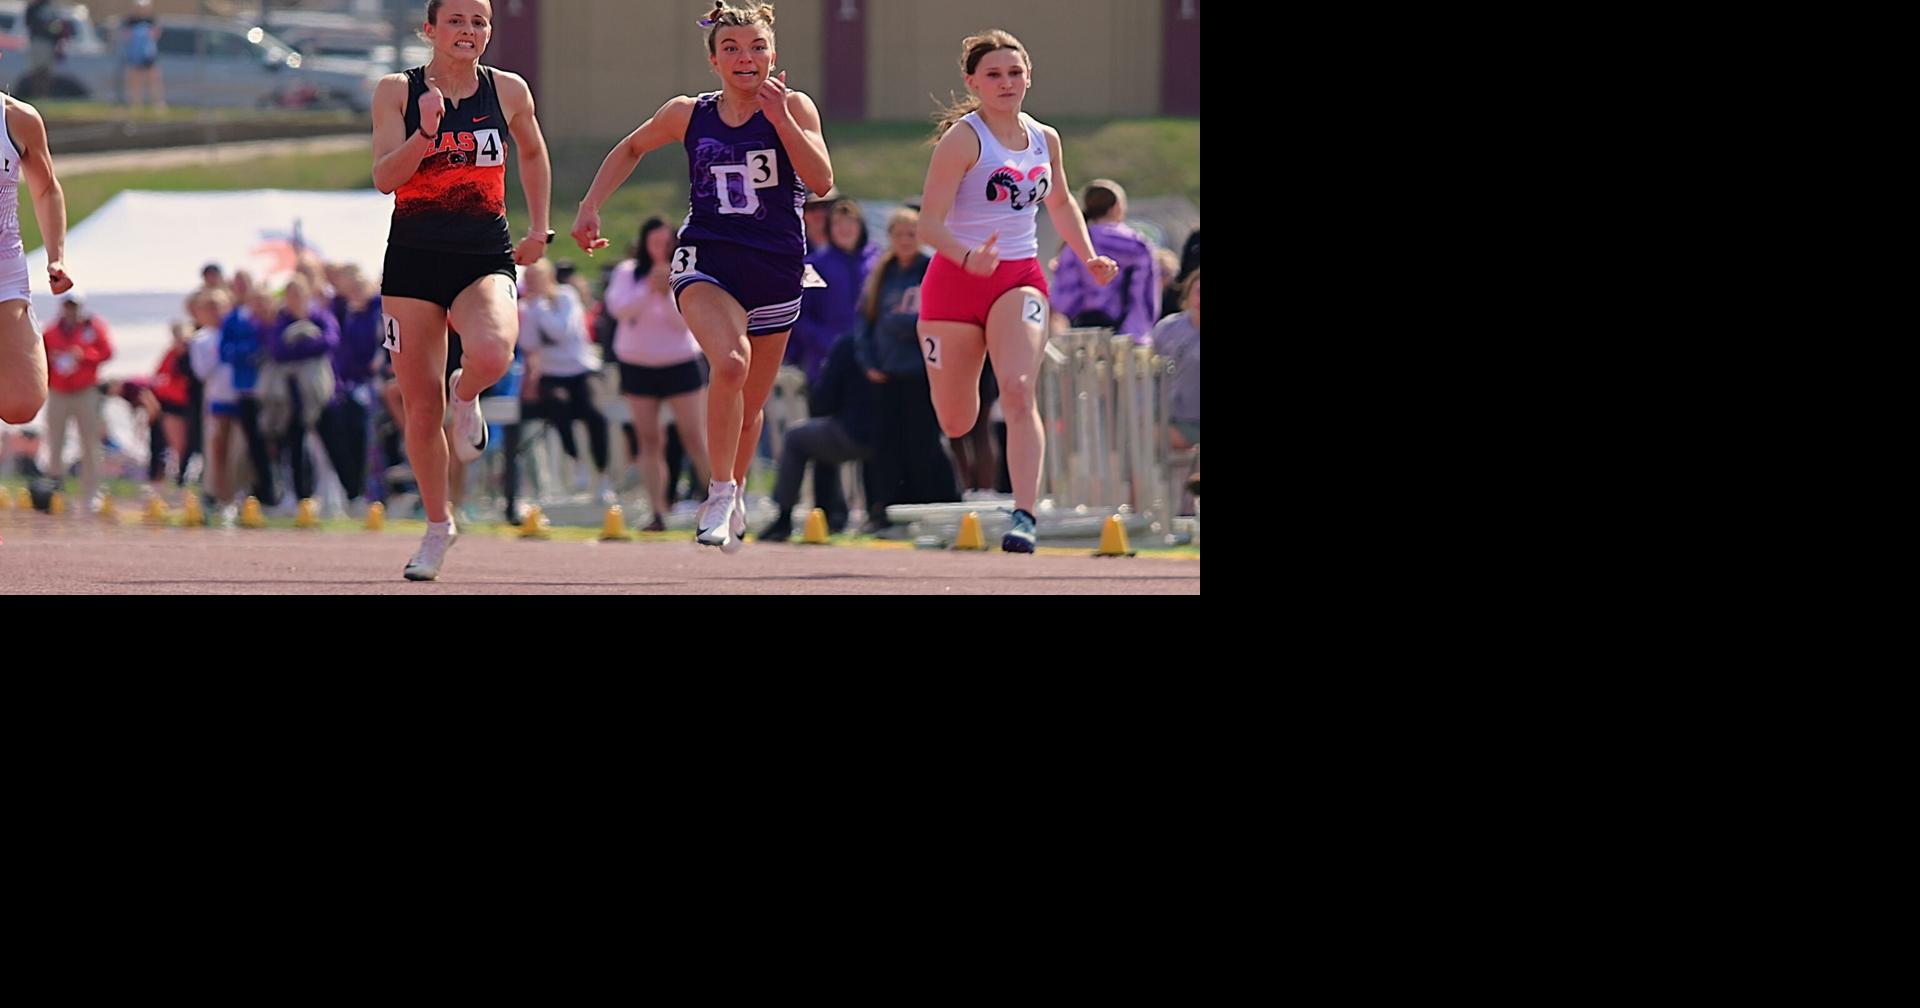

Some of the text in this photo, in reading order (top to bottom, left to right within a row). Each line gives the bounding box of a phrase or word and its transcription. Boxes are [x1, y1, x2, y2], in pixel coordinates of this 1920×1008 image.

[482, 132, 498, 161] 4
[752, 154, 771, 184] 3
[710, 164, 760, 214] D
[1034, 178, 1048, 203] 2
[674, 249, 690, 274] 3
[1026, 300, 1041, 323] 2
[386, 318, 396, 346] 4
[925, 338, 936, 362] 2
